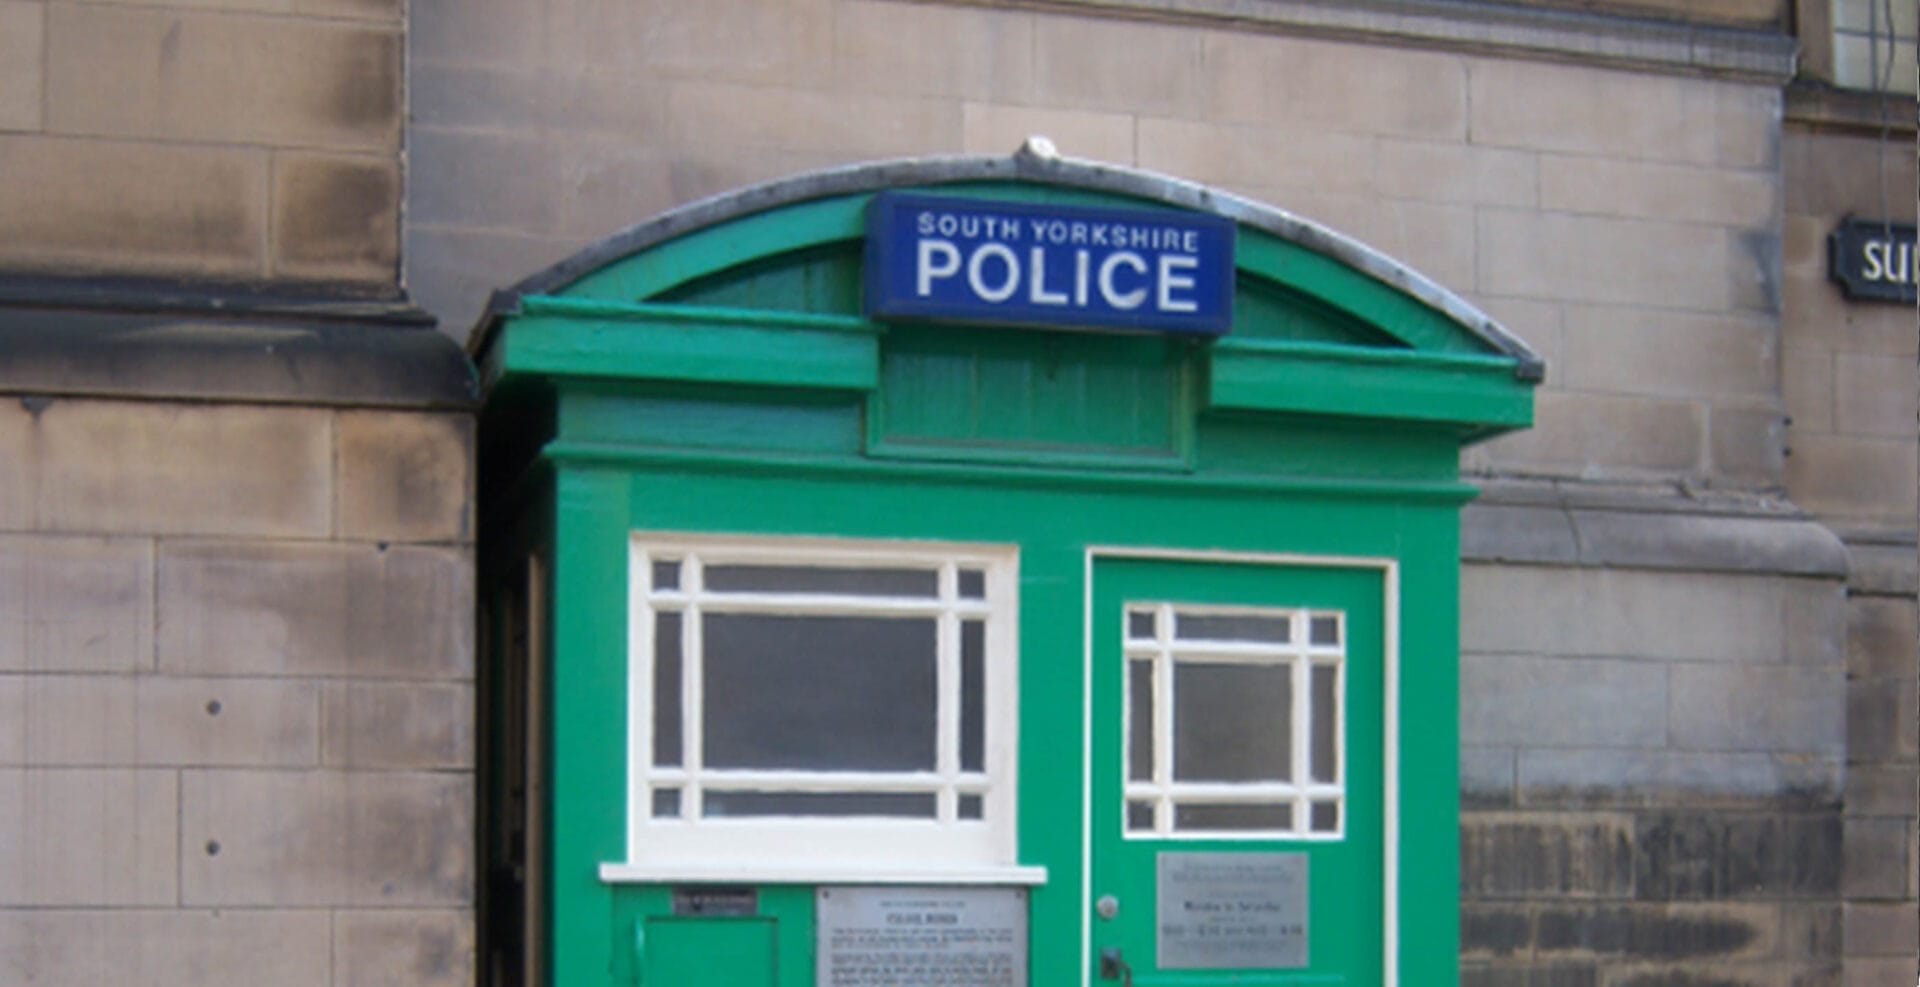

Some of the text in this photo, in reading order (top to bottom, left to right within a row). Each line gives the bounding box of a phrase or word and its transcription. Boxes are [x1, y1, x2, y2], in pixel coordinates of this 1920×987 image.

[917, 211, 1199, 253] SOUTH YORKSHIRE
[917, 239, 1199, 313] POLICE
[1862, 240, 1918, 283] SU
